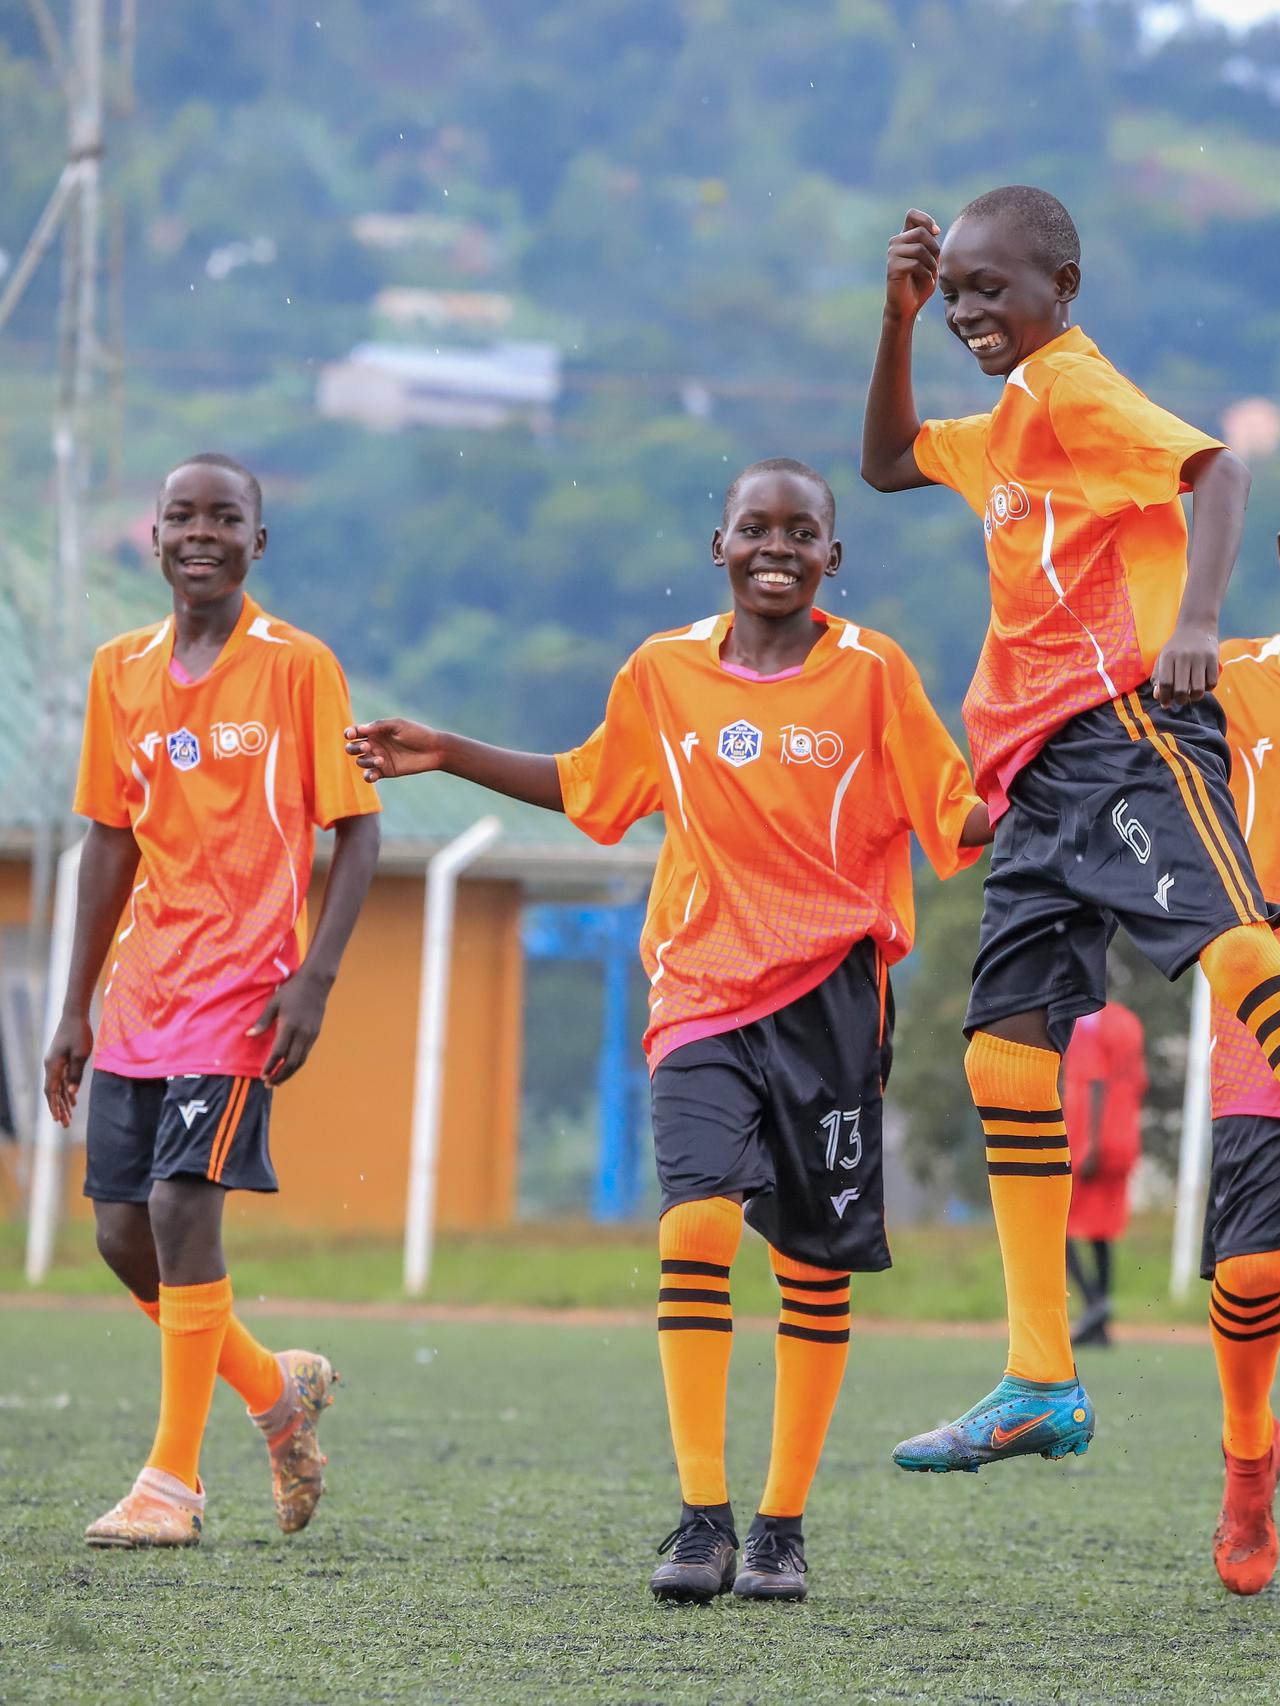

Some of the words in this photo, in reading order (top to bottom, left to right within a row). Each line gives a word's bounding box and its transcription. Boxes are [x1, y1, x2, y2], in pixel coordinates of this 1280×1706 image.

[210, 721, 268, 760] 100
[779, 724, 844, 768] 100
[1111, 798, 1151, 864] 6
[819, 1106, 863, 1171] 13
